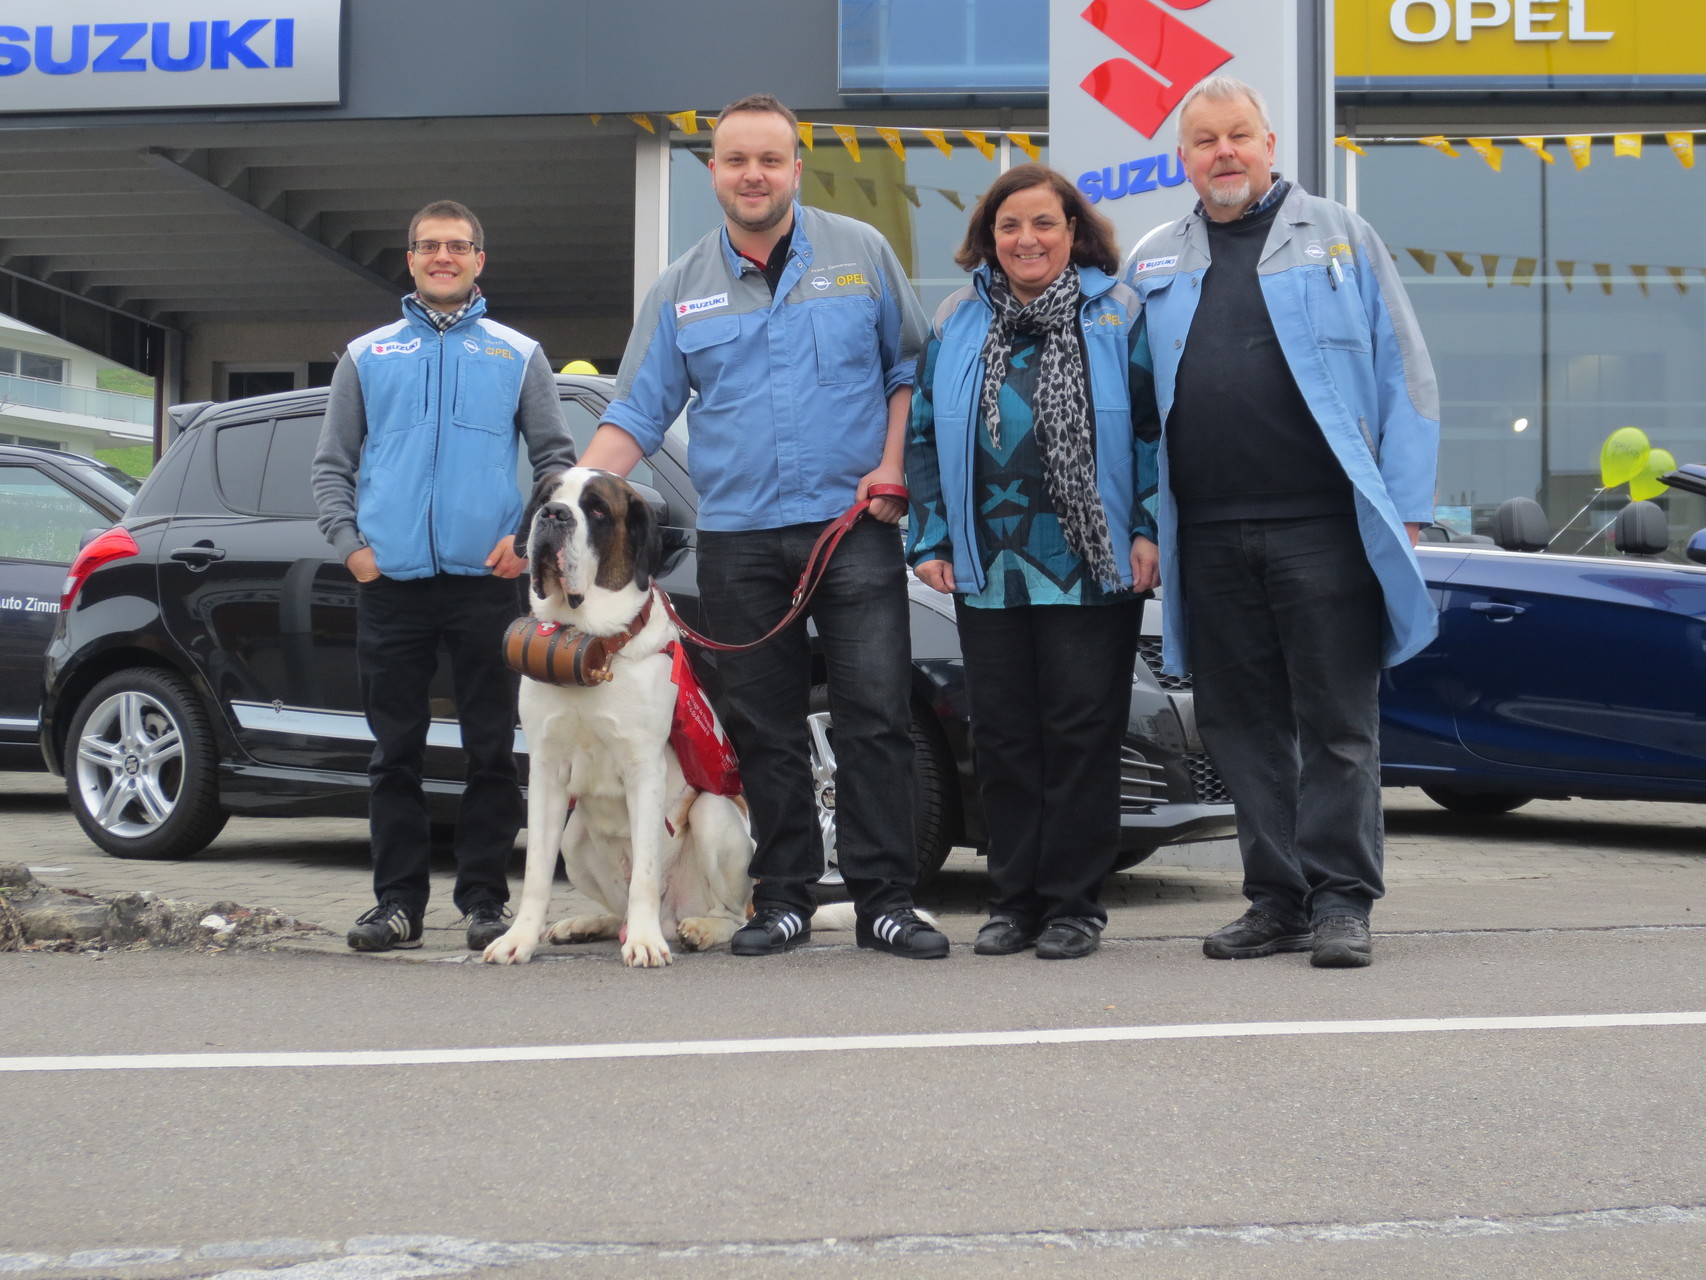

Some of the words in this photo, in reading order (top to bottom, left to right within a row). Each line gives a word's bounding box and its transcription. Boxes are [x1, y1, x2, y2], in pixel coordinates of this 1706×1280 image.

[1390, 0, 1615, 42] OPEL
[0, 18, 294, 77] SUZUKI
[1077, 153, 1191, 205] SUZU
[836, 273, 869, 286] OPEL
[689, 297, 725, 310] SUZUKI
[386, 341, 419, 352] SUZUKI
[484, 346, 515, 361] OPEL
[0, 596, 22, 610] uto
